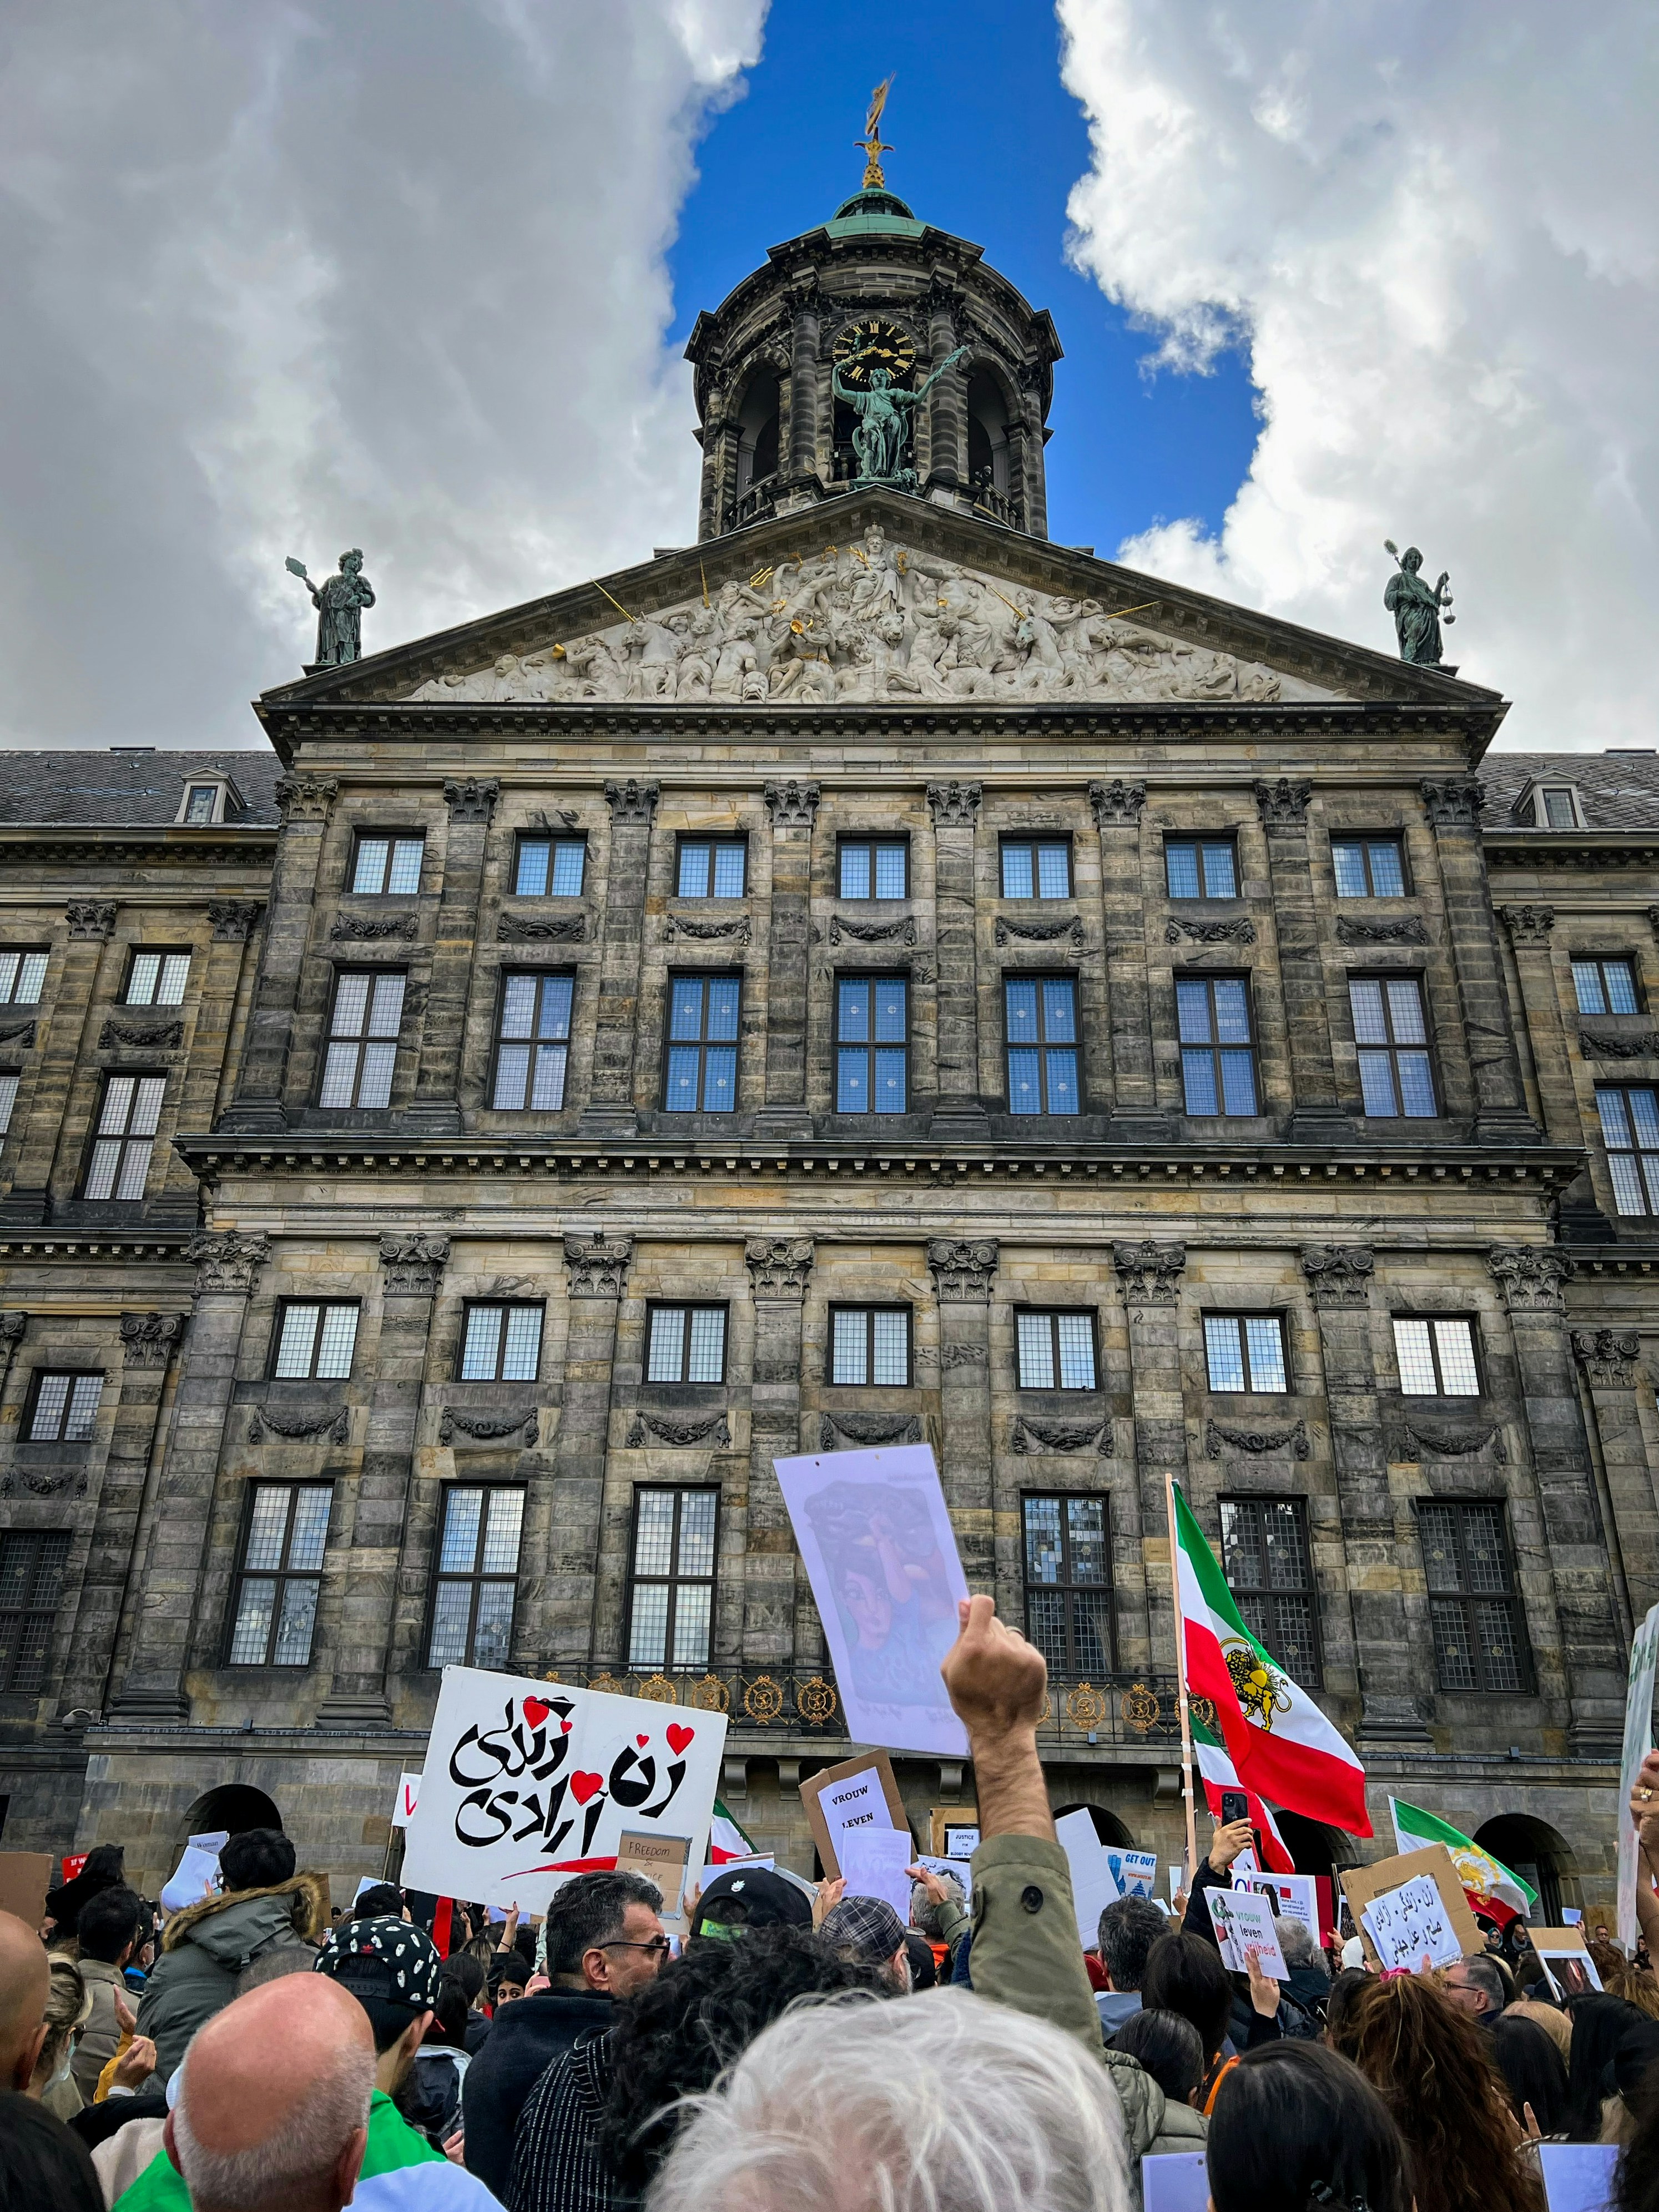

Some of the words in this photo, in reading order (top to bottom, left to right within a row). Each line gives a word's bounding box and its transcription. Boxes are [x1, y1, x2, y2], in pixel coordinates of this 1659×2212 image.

[885, 326, 895, 336] I
[609, 1723, 695, 1819] زن
[832, 1785, 868, 1805] VROUW
[841, 1812, 874, 1828] LEVEN
[628, 1841, 670, 1856] FREEDOM
[1125, 1854, 1139, 1863] GET
[1140, 1856, 1155, 1866] OUT
[1421, 1885, 1434, 1907] زن
[1399, 1891, 1418, 1922] زندگی
[1236, 1911, 1261, 1923] vrouw
[1239, 1924, 1263, 1939] leven
